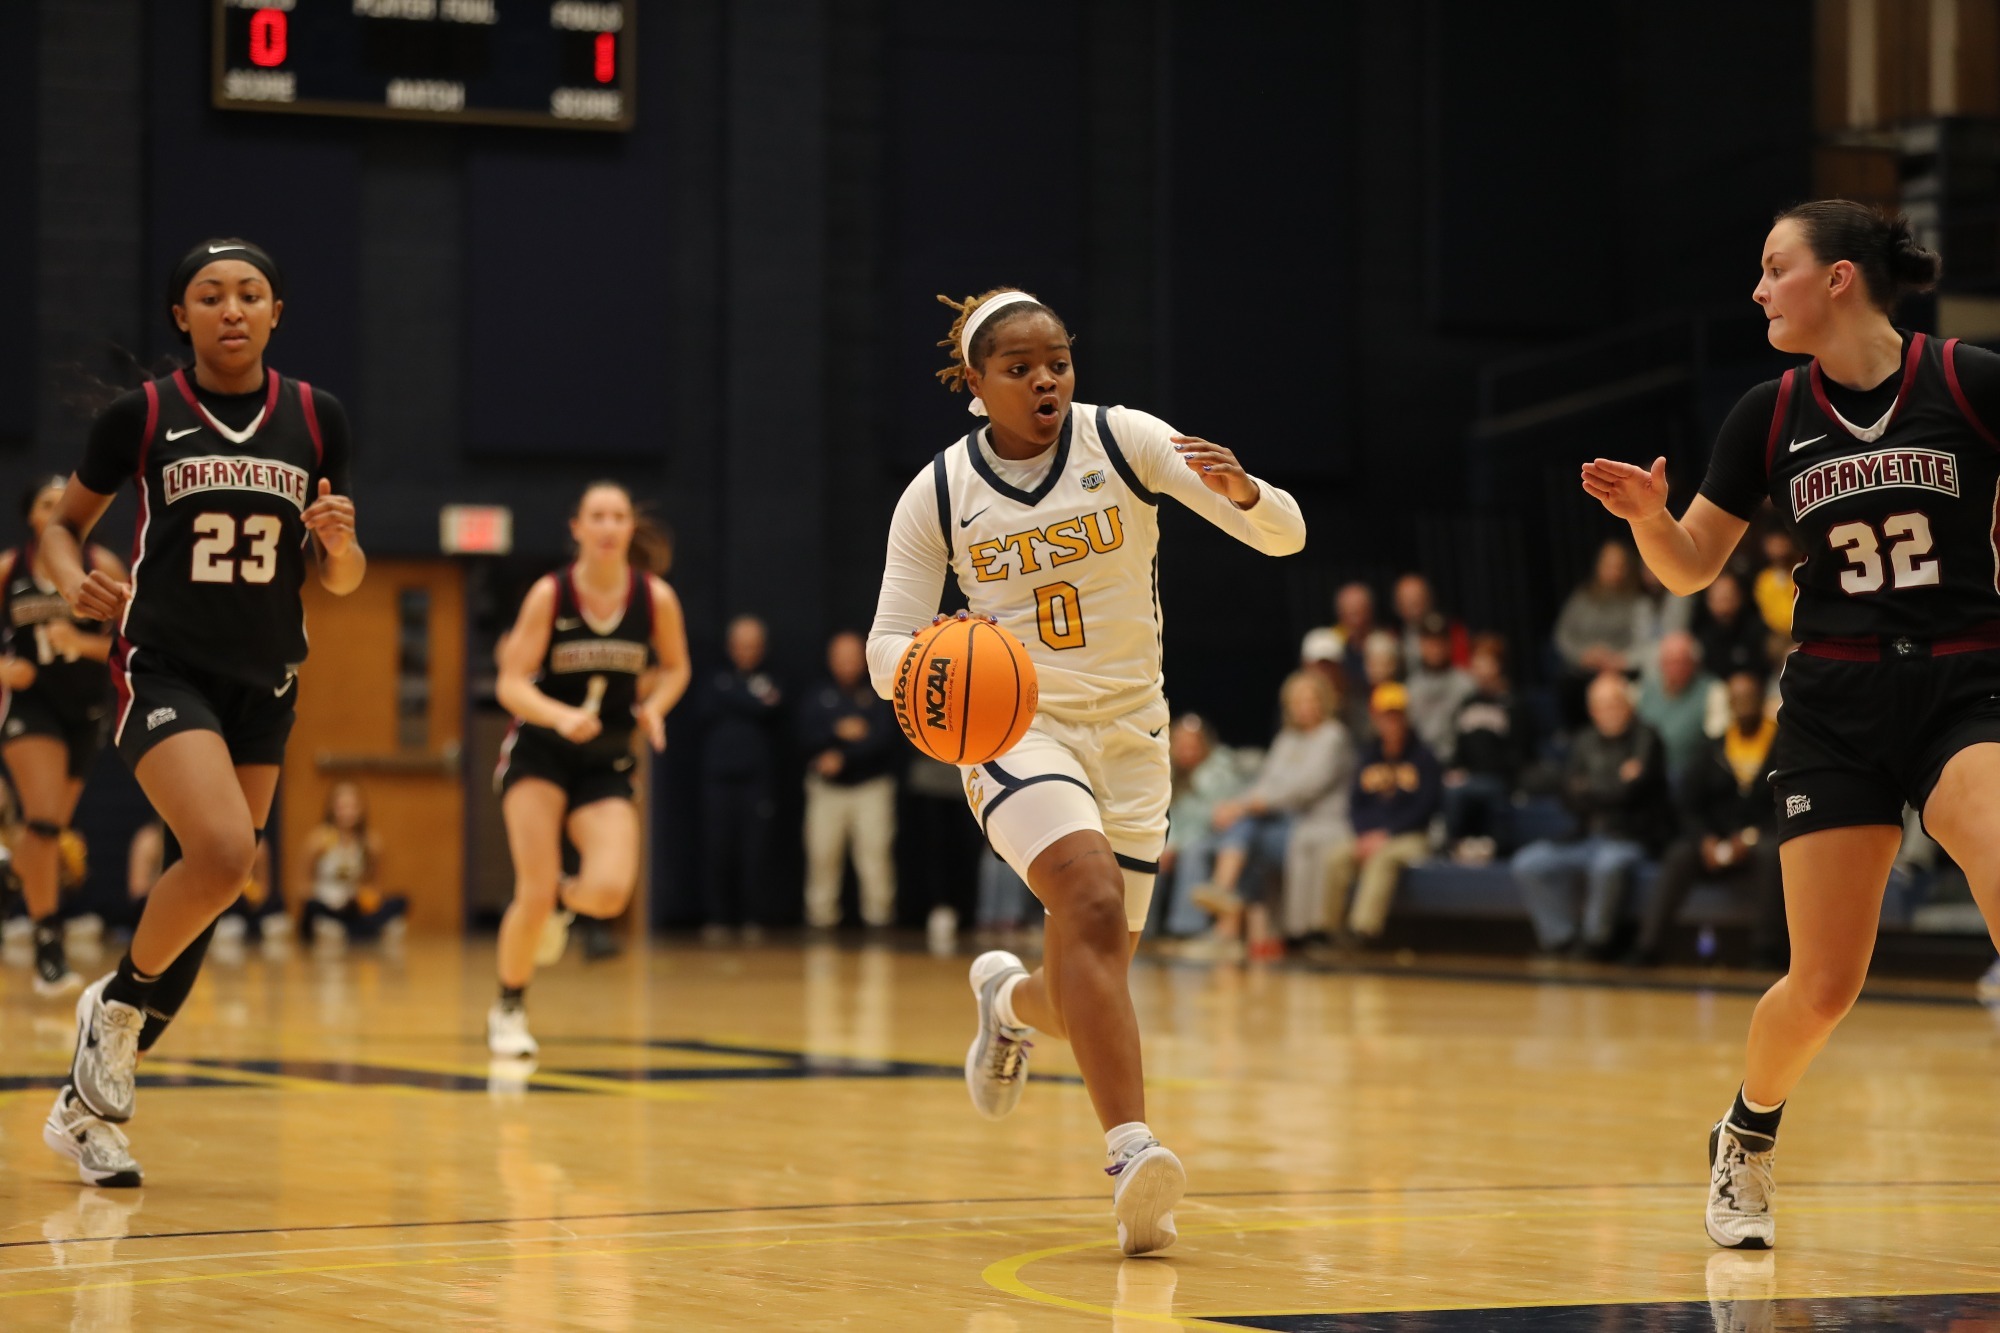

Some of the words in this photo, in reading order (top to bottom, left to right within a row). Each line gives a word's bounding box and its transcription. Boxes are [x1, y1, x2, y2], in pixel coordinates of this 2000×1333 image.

[249, 7, 288, 66] 0
[594, 31, 615, 83] 1
[165, 458, 307, 503] LAFAYETTE
[1791, 450, 1957, 516] LAFAYETTE
[190, 511, 283, 585] 23
[968, 505, 1124, 583] ETSU
[1827, 509, 1942, 596] 32
[1033, 580, 1087, 651] 0
[925, 657, 952, 732] NCAA
